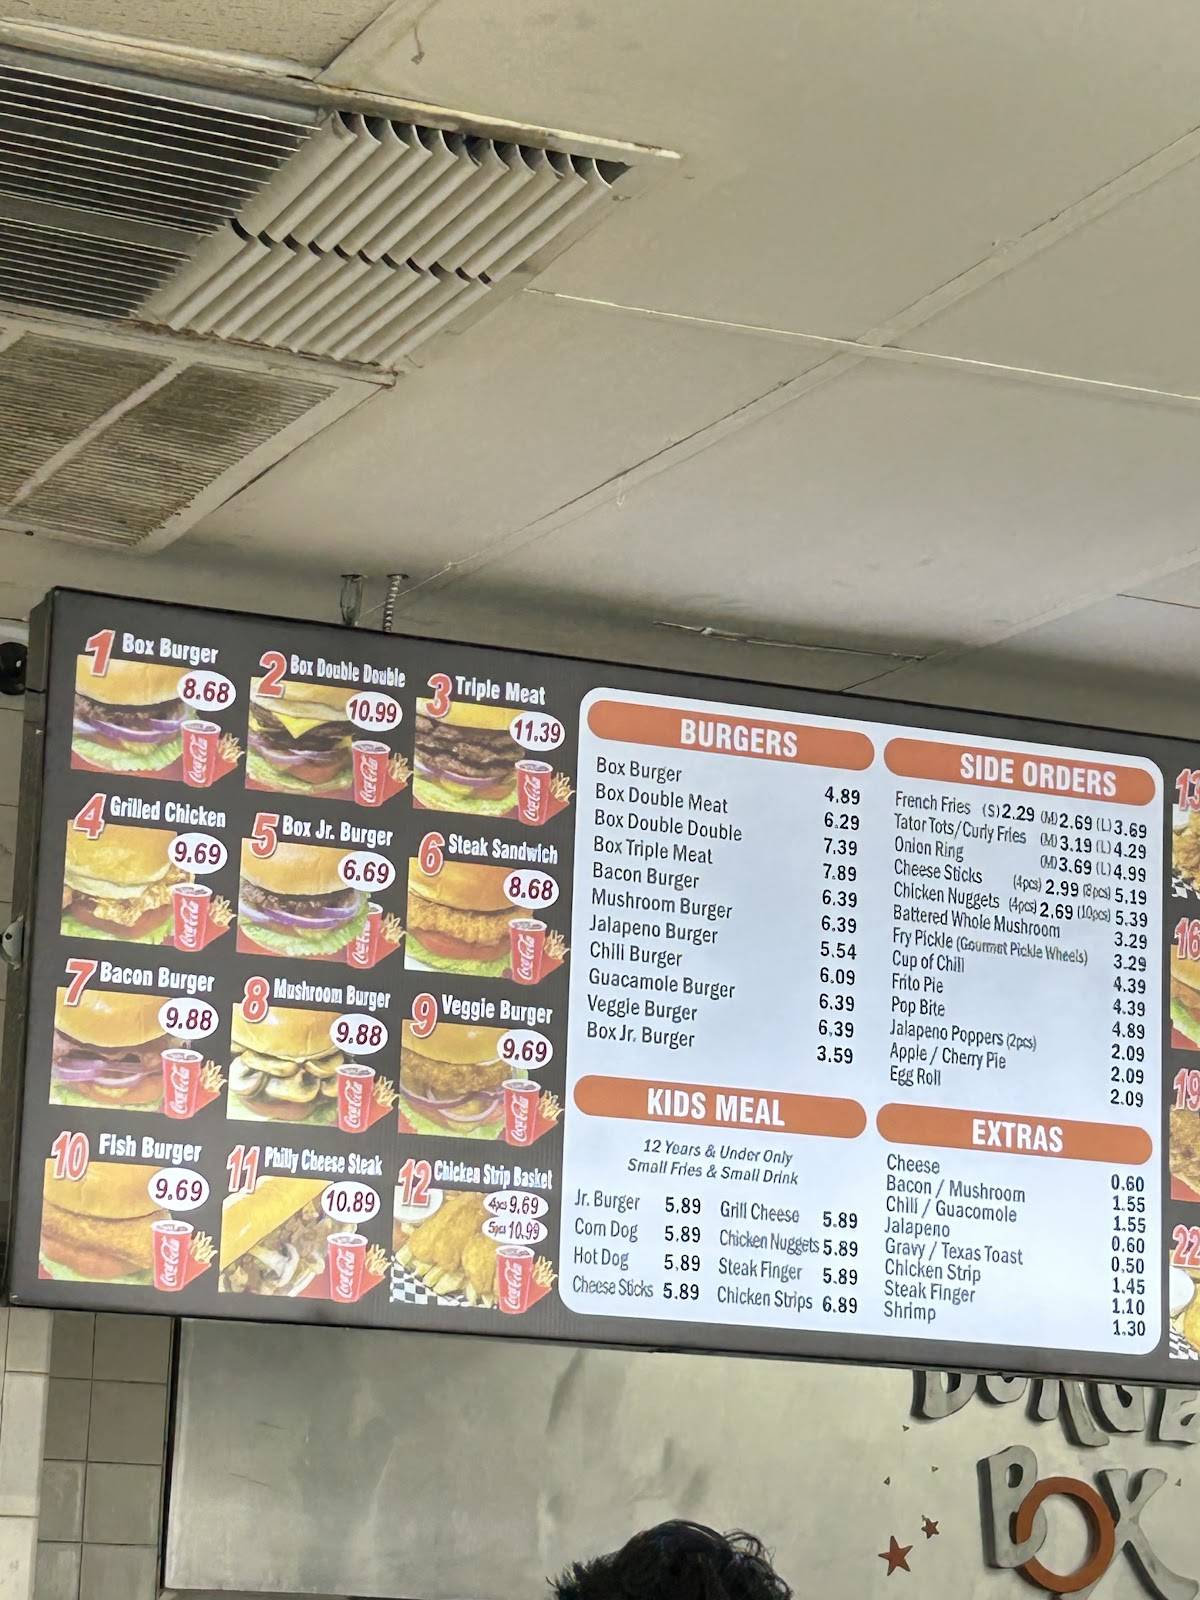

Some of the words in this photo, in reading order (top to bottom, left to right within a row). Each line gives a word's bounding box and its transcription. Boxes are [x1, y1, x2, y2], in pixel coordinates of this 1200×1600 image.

[85, 629, 115, 676] 1
[123, 633, 154, 655] Box
[160, 638, 219, 665] Burger
[182, 679, 230, 703] 8.68
[256, 650, 287, 698] 2
[349, 699, 396, 723] 10.99
[426, 673, 452, 718] 3
[456, 676, 500, 700] Triple
[506, 682, 546, 705] Meat
[514, 720, 560, 743] 11.39
[680, 719, 798, 758] BURGERS
[597, 756, 625, 776] Box
[630, 760, 682, 784] Burger
[824, 786, 860, 805] 4.89
[960, 753, 1014, 784] SIDE
[1023, 762, 1117, 797] ORDERS
[74, 793, 106, 840] 4
[110, 796, 160, 820] Grilled
[165, 802, 226, 828] Chicken
[596, 783, 624, 802] Box
[629, 786, 684, 808] Double
[689, 794, 728, 814] Meat
[824, 812, 859, 830] 6.29
[894, 813, 927, 832] Tator
[896, 791, 937, 811] French
[942, 796, 971, 815] Fries
[251, 812, 278, 858] 5
[283, 816, 311, 837] Box
[341, 822, 393, 848] Burger
[595, 808, 624, 828] Box
[628, 813, 683, 834] Double
[688, 819, 742, 841] Double
[824, 837, 857, 856] 7.39
[936, 840, 964, 863] Ring
[175, 841, 221, 865] 9.69
[343, 859, 389, 883] 6.69
[418, 832, 445, 876] 6
[449, 834, 488, 857] Steak
[493, 839, 558, 864] Sandwich
[594, 836, 622, 854] Box
[626, 838, 668, 861] Triple
[673, 844, 713, 864] Meat
[823, 863, 856, 882] 7.89
[509, 877, 553, 900] 8.68
[593, 862, 641, 883] Bacon
[647, 868, 699, 891] Burger
[822, 889, 857, 908] 6.39
[894, 858, 941, 879] Cheese
[1045, 879, 1079, 898] 2.99
[1115, 887, 1146, 905] 5.19
[592, 888, 675, 913] Mushroom
[680, 898, 732, 921] Burger
[822, 915, 856, 934] 6.39
[894, 881, 944, 903] Chicken
[948, 887, 1000, 910] Nuggets
[1040, 902, 1073, 920] 2.69
[1116, 910, 1148, 928] 5.39
[589, 914, 660, 938] Jalapeno
[666, 922, 718, 946] Burger
[820, 941, 856, 960] 5.54
[894, 904, 948, 925] Battered
[952, 910, 990, 930] Whole
[994, 914, 1060, 938] Mushroom
[1114, 931, 1147, 950] 3.29
[64, 958, 98, 1006] 7
[100, 962, 153, 986] Bacon
[158, 967, 215, 994] Burger
[630, 945, 682, 968] Burger
[820, 967, 855, 986] 6.09
[892, 950, 918, 971] Cup
[921, 953, 934, 970] of
[1113, 976, 1146, 994] 4.39
[242, 976, 270, 1022] 8
[273, 978, 343, 1007] Mushroom
[346, 985, 391, 1012] Burger
[589, 968, 678, 992] Guacamole
[683, 977, 735, 1000] Burger
[819, 993, 854, 1012] 6.39
[924, 976, 943, 994] Pie
[1113, 998, 1145, 1017] 4.39
[166, 1007, 212, 1031] 9.88
[336, 1022, 382, 1045] 9.88
[409, 993, 437, 1038] 9
[442, 994, 495, 1020] Veggie
[500, 1000, 553, 1026] Burger
[588, 994, 640, 1018] Veggie
[645, 1000, 697, 1024] Burger
[818, 1019, 854, 1038] 6.39
[892, 996, 916, 1017] Pop
[1112, 1021, 1145, 1040] 4.89
[502, 1039, 547, 1062] 9.69
[587, 1021, 616, 1040] Box
[642, 1026, 695, 1050] Burger
[817, 1045, 853, 1064] 3.59
[890, 1019, 948, 1041] Jalapeno
[952, 1025, 1004, 1048] Poppers
[1112, 1043, 1144, 1062] 2.09
[890, 1042, 927, 1064] Apple
[986, 1052, 1006, 1069] Pie
[1111, 1066, 1144, 1084] 2.09
[890, 1065, 914, 1086] Egg
[917, 1068, 940, 1086] Roll
[1110, 1088, 1144, 1108] 2.09
[647, 1088, 706, 1120] KIDS
[716, 1094, 786, 1126] MEAL
[52, 1131, 90, 1180] 10
[142, 1136, 202, 1164] Burger
[972, 1119, 1063, 1152] EXTRAS
[226, 1145, 260, 1193] 11
[398, 1158, 432, 1206] 12
[887, 1154, 940, 1174] Cheese
[1111, 1174, 1144, 1192] 0.60
[155, 1178, 203, 1201] 9.69
[326, 1190, 375, 1213] 10.89
[594, 1190, 640, 1213] Burger
[666, 1196, 701, 1214] 5.89
[887, 1174, 931, 1194] Bacon
[950, 1180, 1025, 1202] Mushroom
[1113, 1195, 1145, 1213] 1.55
[611, 1220, 638, 1243] Dog
[665, 1225, 700, 1243] 5.89
[720, 1200, 747, 1219] Grill
[751, 1203, 799, 1223] Cheese
[823, 1211, 857, 1229] 5.89
[1113, 1216, 1146, 1233] 1.55
[720, 1229, 767, 1249] Chicken
[823, 1239, 858, 1257] 5.89
[884, 1217, 950, 1239] Jalapeno
[1112, 1236, 1144, 1254] 0.60
[574, 1246, 598, 1264] Hot
[602, 1248, 629, 1271] Dog
[664, 1254, 700, 1272] 5.89
[719, 1257, 757, 1277] Steak
[823, 1268, 858, 1285] 5.89
[885, 1258, 942, 1279] Chicken
[1113, 1277, 1145, 1295] 1.45
[942, 1242, 981, 1261] Texas
[984, 1246, 1023, 1265] Toast
[1112, 1256, 1144, 1274] 0.50
[663, 1282, 699, 1300] 5.89
[718, 1286, 770, 1306] Chicken
[823, 1296, 857, 1314] 6.89
[884, 1280, 926, 1299] Steak
[1112, 1298, 1144, 1316] 1.10
[1113, 1319, 1146, 1336] 1.30
